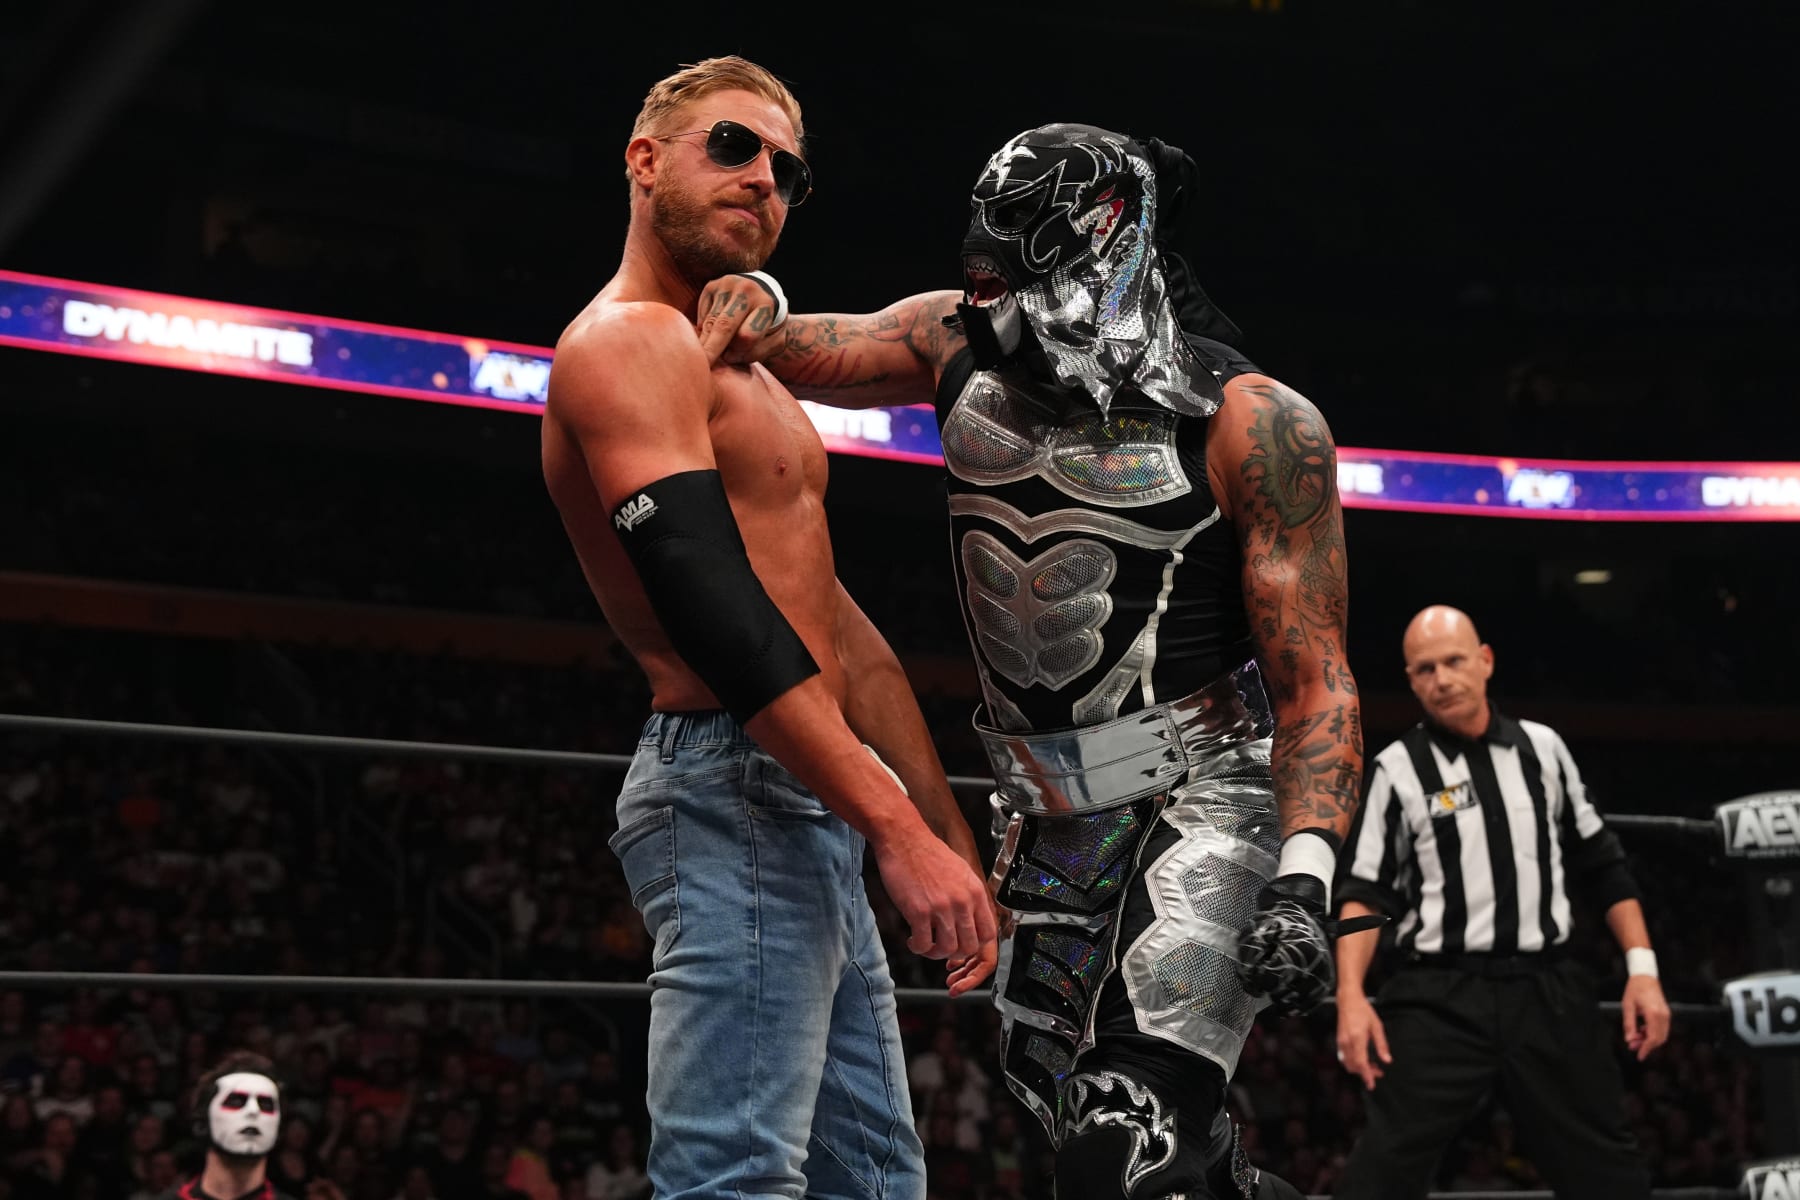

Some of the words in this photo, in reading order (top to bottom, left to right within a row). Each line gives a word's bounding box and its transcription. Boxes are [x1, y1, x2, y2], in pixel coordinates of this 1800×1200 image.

[63, 300, 313, 367] DYNAMITE
[614, 493, 655, 532] AMA
[1430, 782, 1470, 816] AEW
